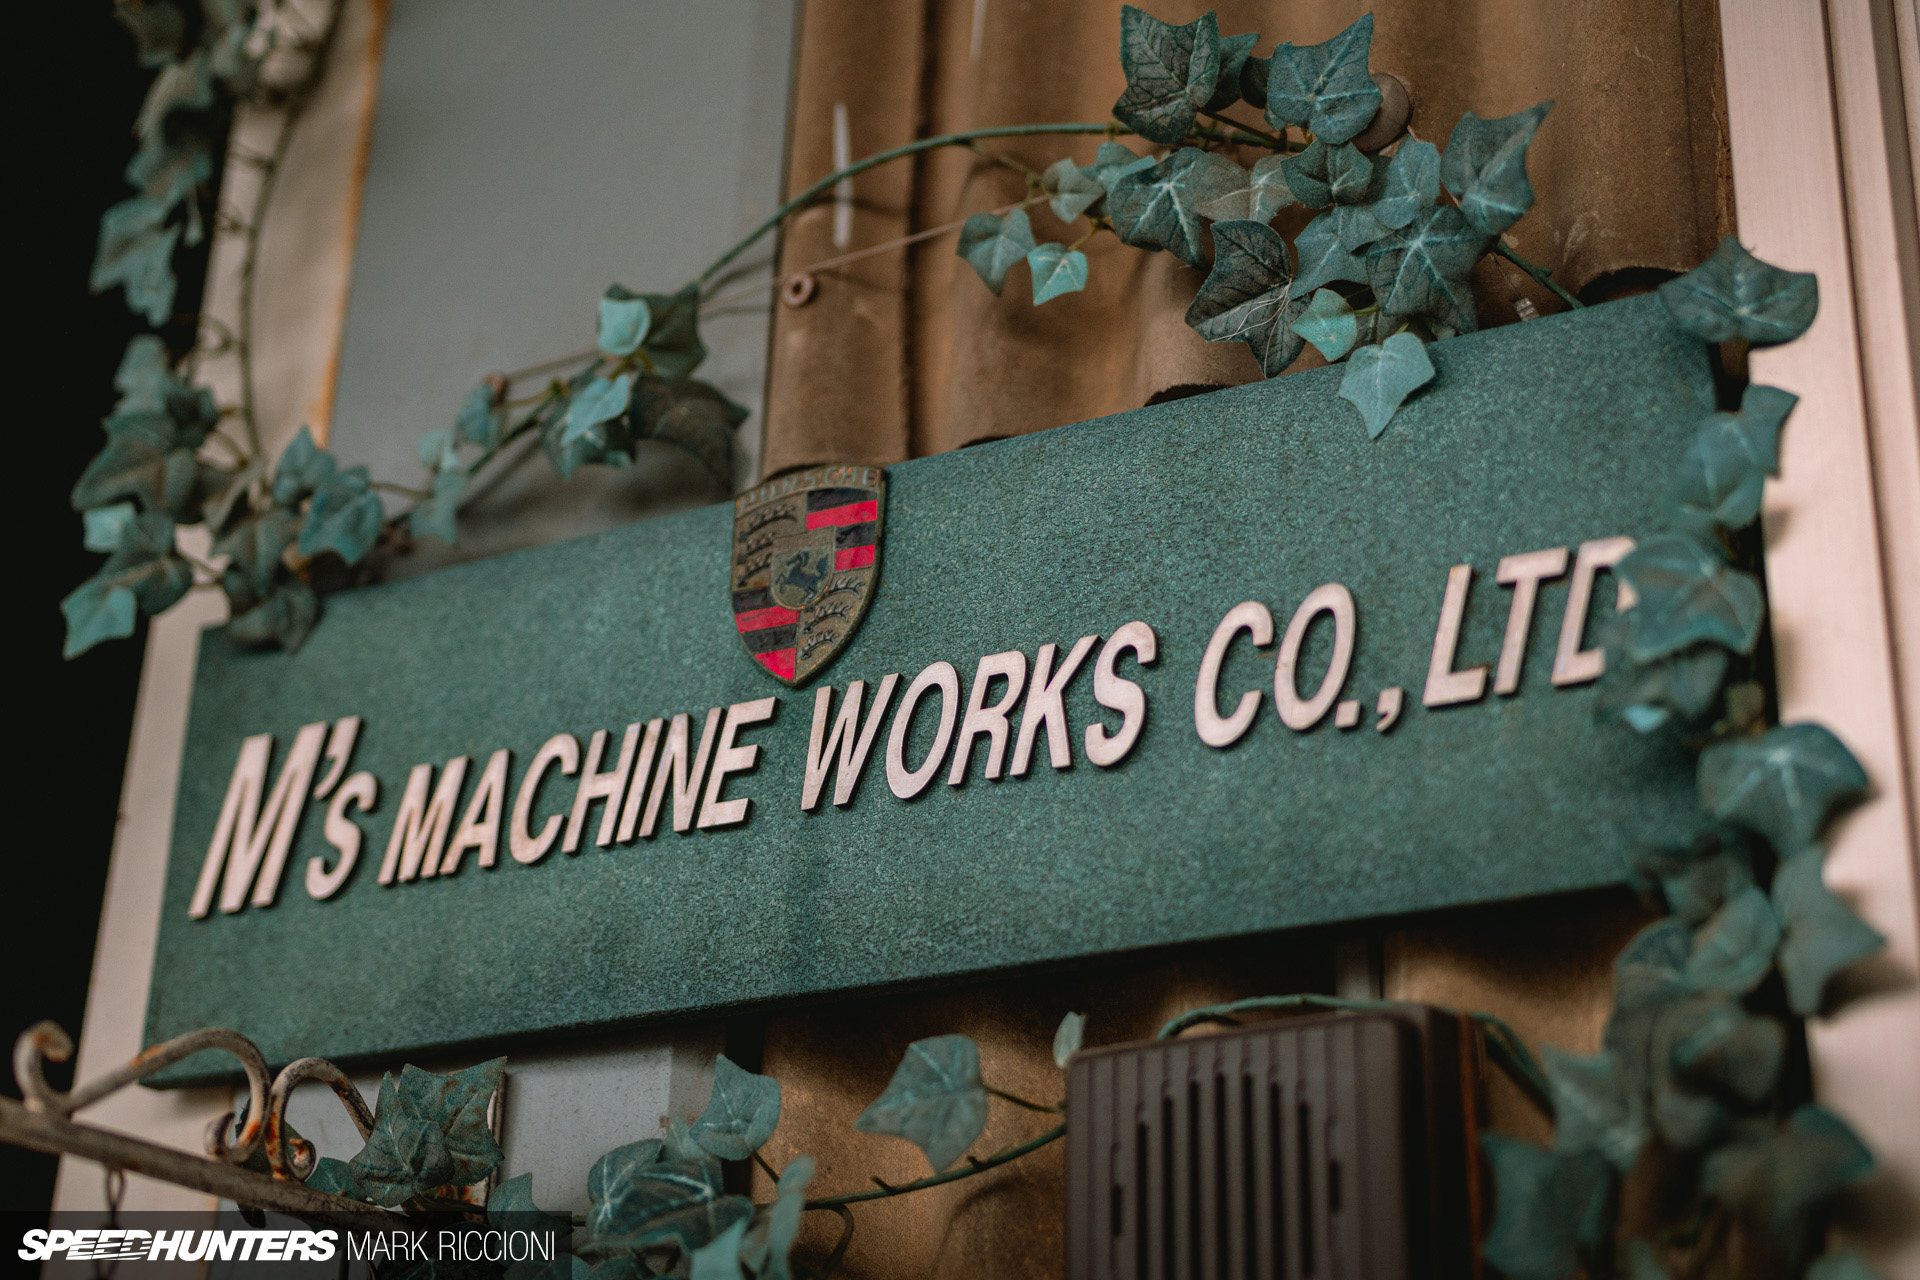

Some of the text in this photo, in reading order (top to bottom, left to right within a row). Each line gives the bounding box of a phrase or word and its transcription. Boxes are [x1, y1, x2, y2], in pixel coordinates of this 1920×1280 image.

[189, 715, 378, 920] M's
[377, 696, 777, 886] MACHINE
[801, 620, 1159, 811] WORKS
